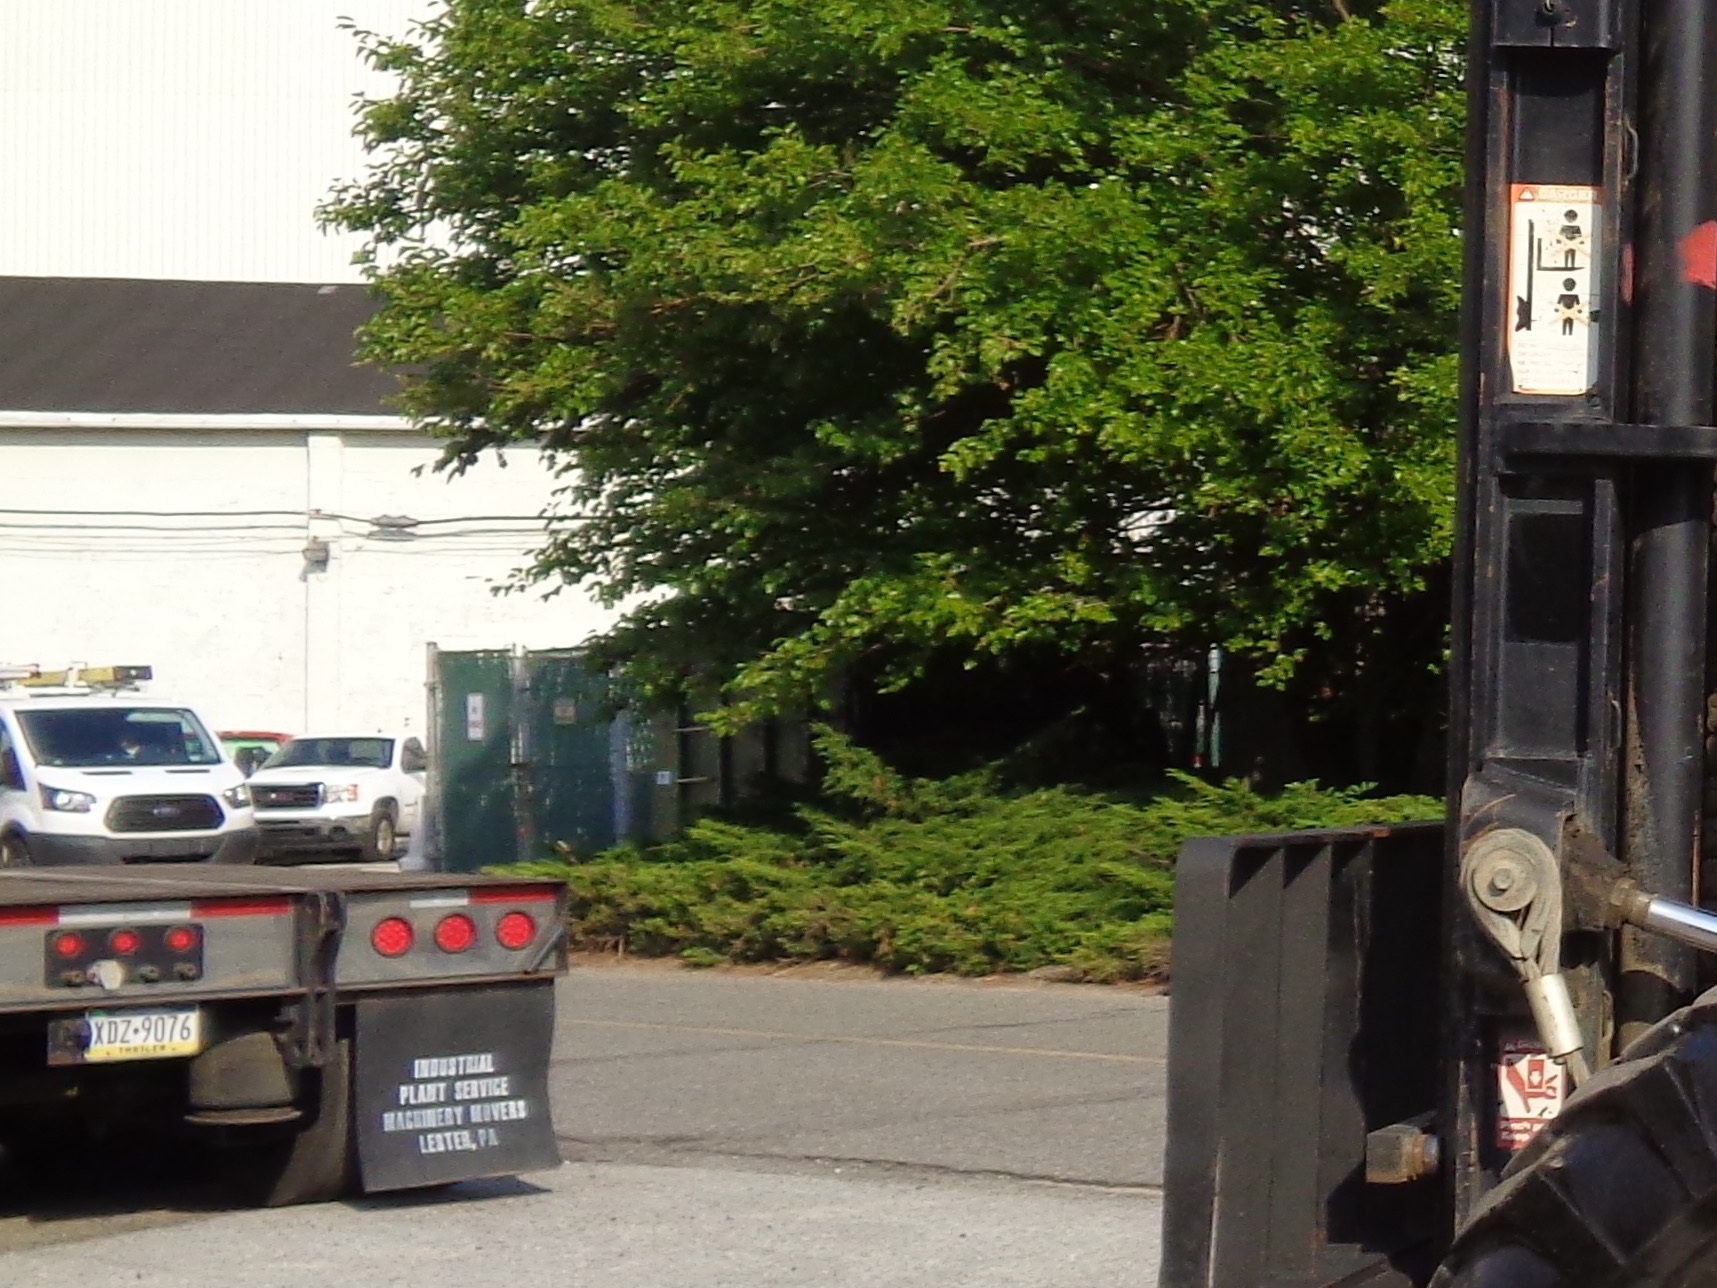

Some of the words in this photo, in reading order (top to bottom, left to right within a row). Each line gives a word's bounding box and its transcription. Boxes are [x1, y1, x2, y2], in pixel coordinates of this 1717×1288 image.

[414, 1053, 496, 1079] INDUSTRIAL
[399, 1082, 447, 1106] PLANT
[454, 1076, 510, 1101] SERVICE
[383, 1106, 464, 1132] MACHINERY
[470, 1099, 527, 1123] MOVERS
[477, 1128, 499, 1148] PA
